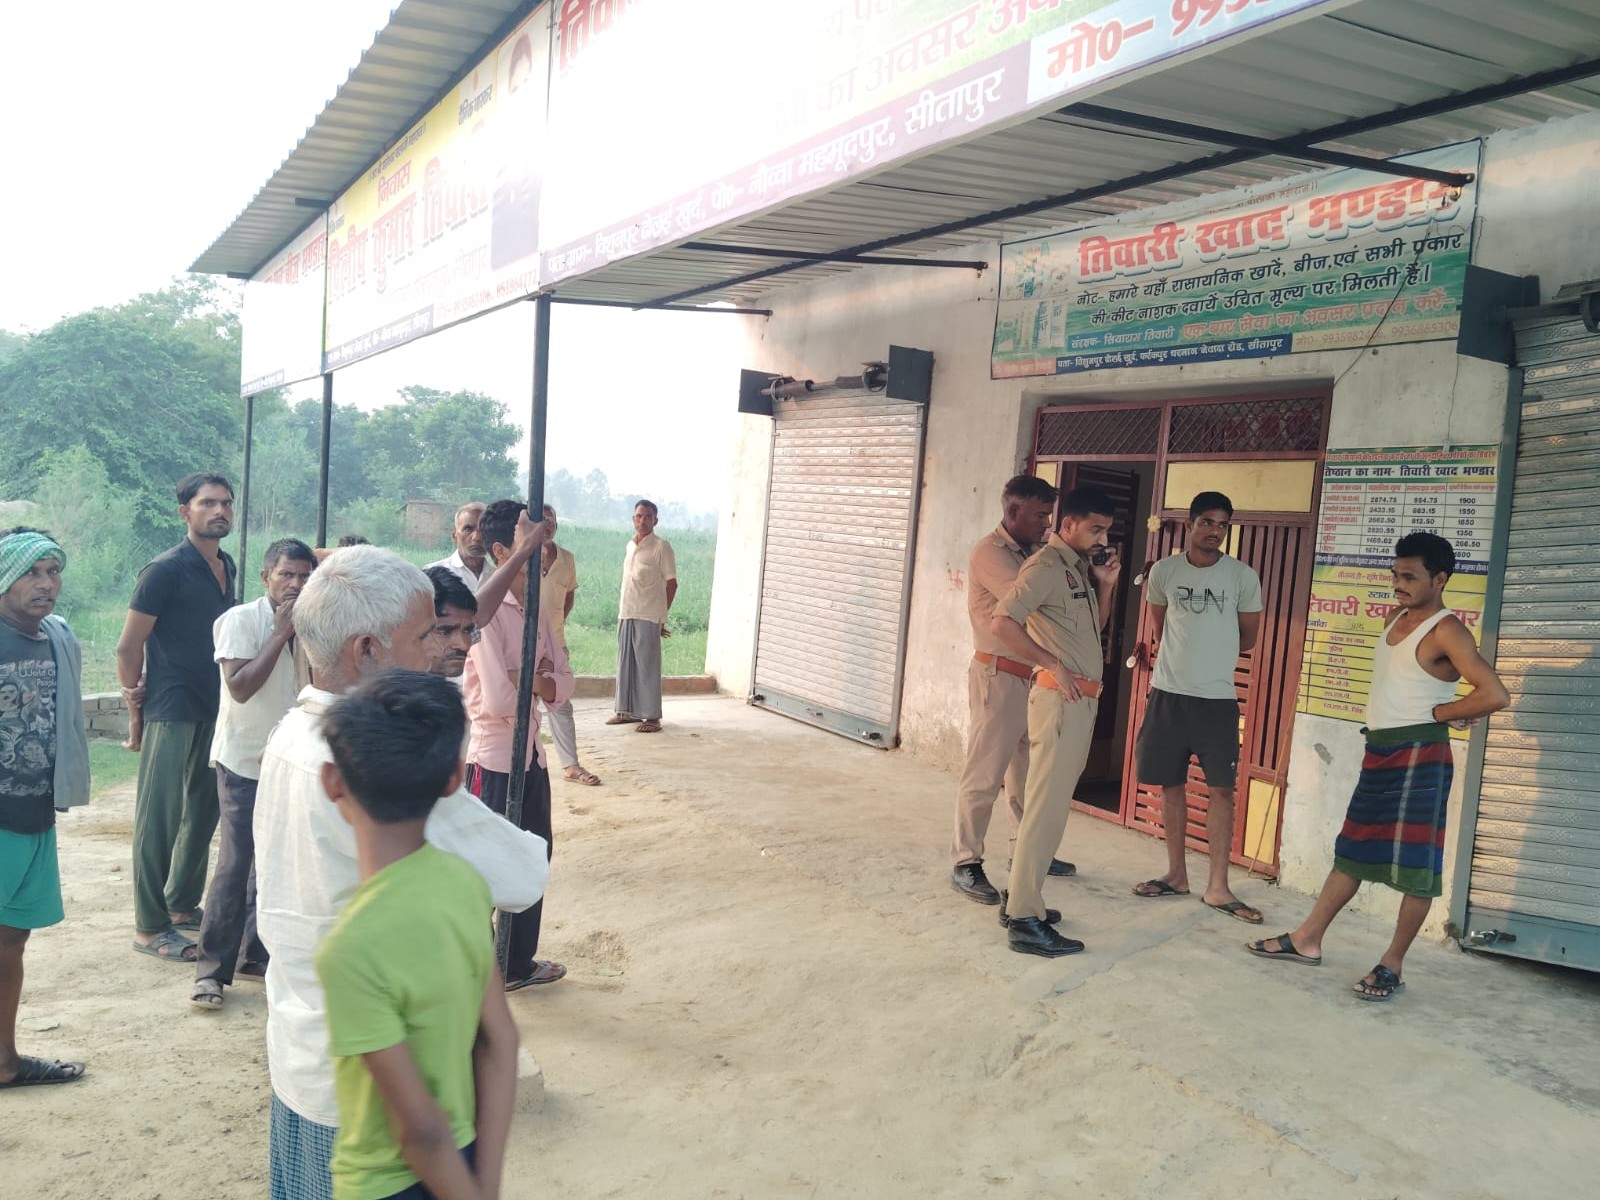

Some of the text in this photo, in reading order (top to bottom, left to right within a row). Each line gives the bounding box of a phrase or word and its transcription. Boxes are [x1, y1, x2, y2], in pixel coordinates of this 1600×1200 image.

[904, 67, 1006, 135] सीतापुर
[1078, 221, 1185, 277] तिवारी
[1195, 204, 1291, 255] खाद
[1108, 284, 1140, 303] हमारे
[1171, 268, 1246, 291] रासायनिक
[1364, 237, 1407, 263] सभी
[1411, 233, 1465, 255] प्रकार
[1091, 310, 1107, 325] की
[1111, 308, 1135, 322] कीट
[1138, 303, 1179, 320] नाशक
[1224, 290, 1265, 309] उचित
[1269, 284, 1308, 307] मूल्य
[1311, 280, 1337, 297] पर
[1342, 269, 1401, 293] मिलती
[1184, 323, 1206, 338] एक
[1209, 320, 1236, 335] बार
[1240, 312, 1274, 332] सेवा
[1276, 311, 1299, 327] का
[1302, 303, 1360, 324] अवसर
[1247, 338, 1285, 351] सीतापुर
[1355, 467, 1369, 476] का
[1400, 465, 1431, 477] तिवारी
[1435, 466, 1458, 476] खाद
[1176, 586, 1225, 614] RUN
